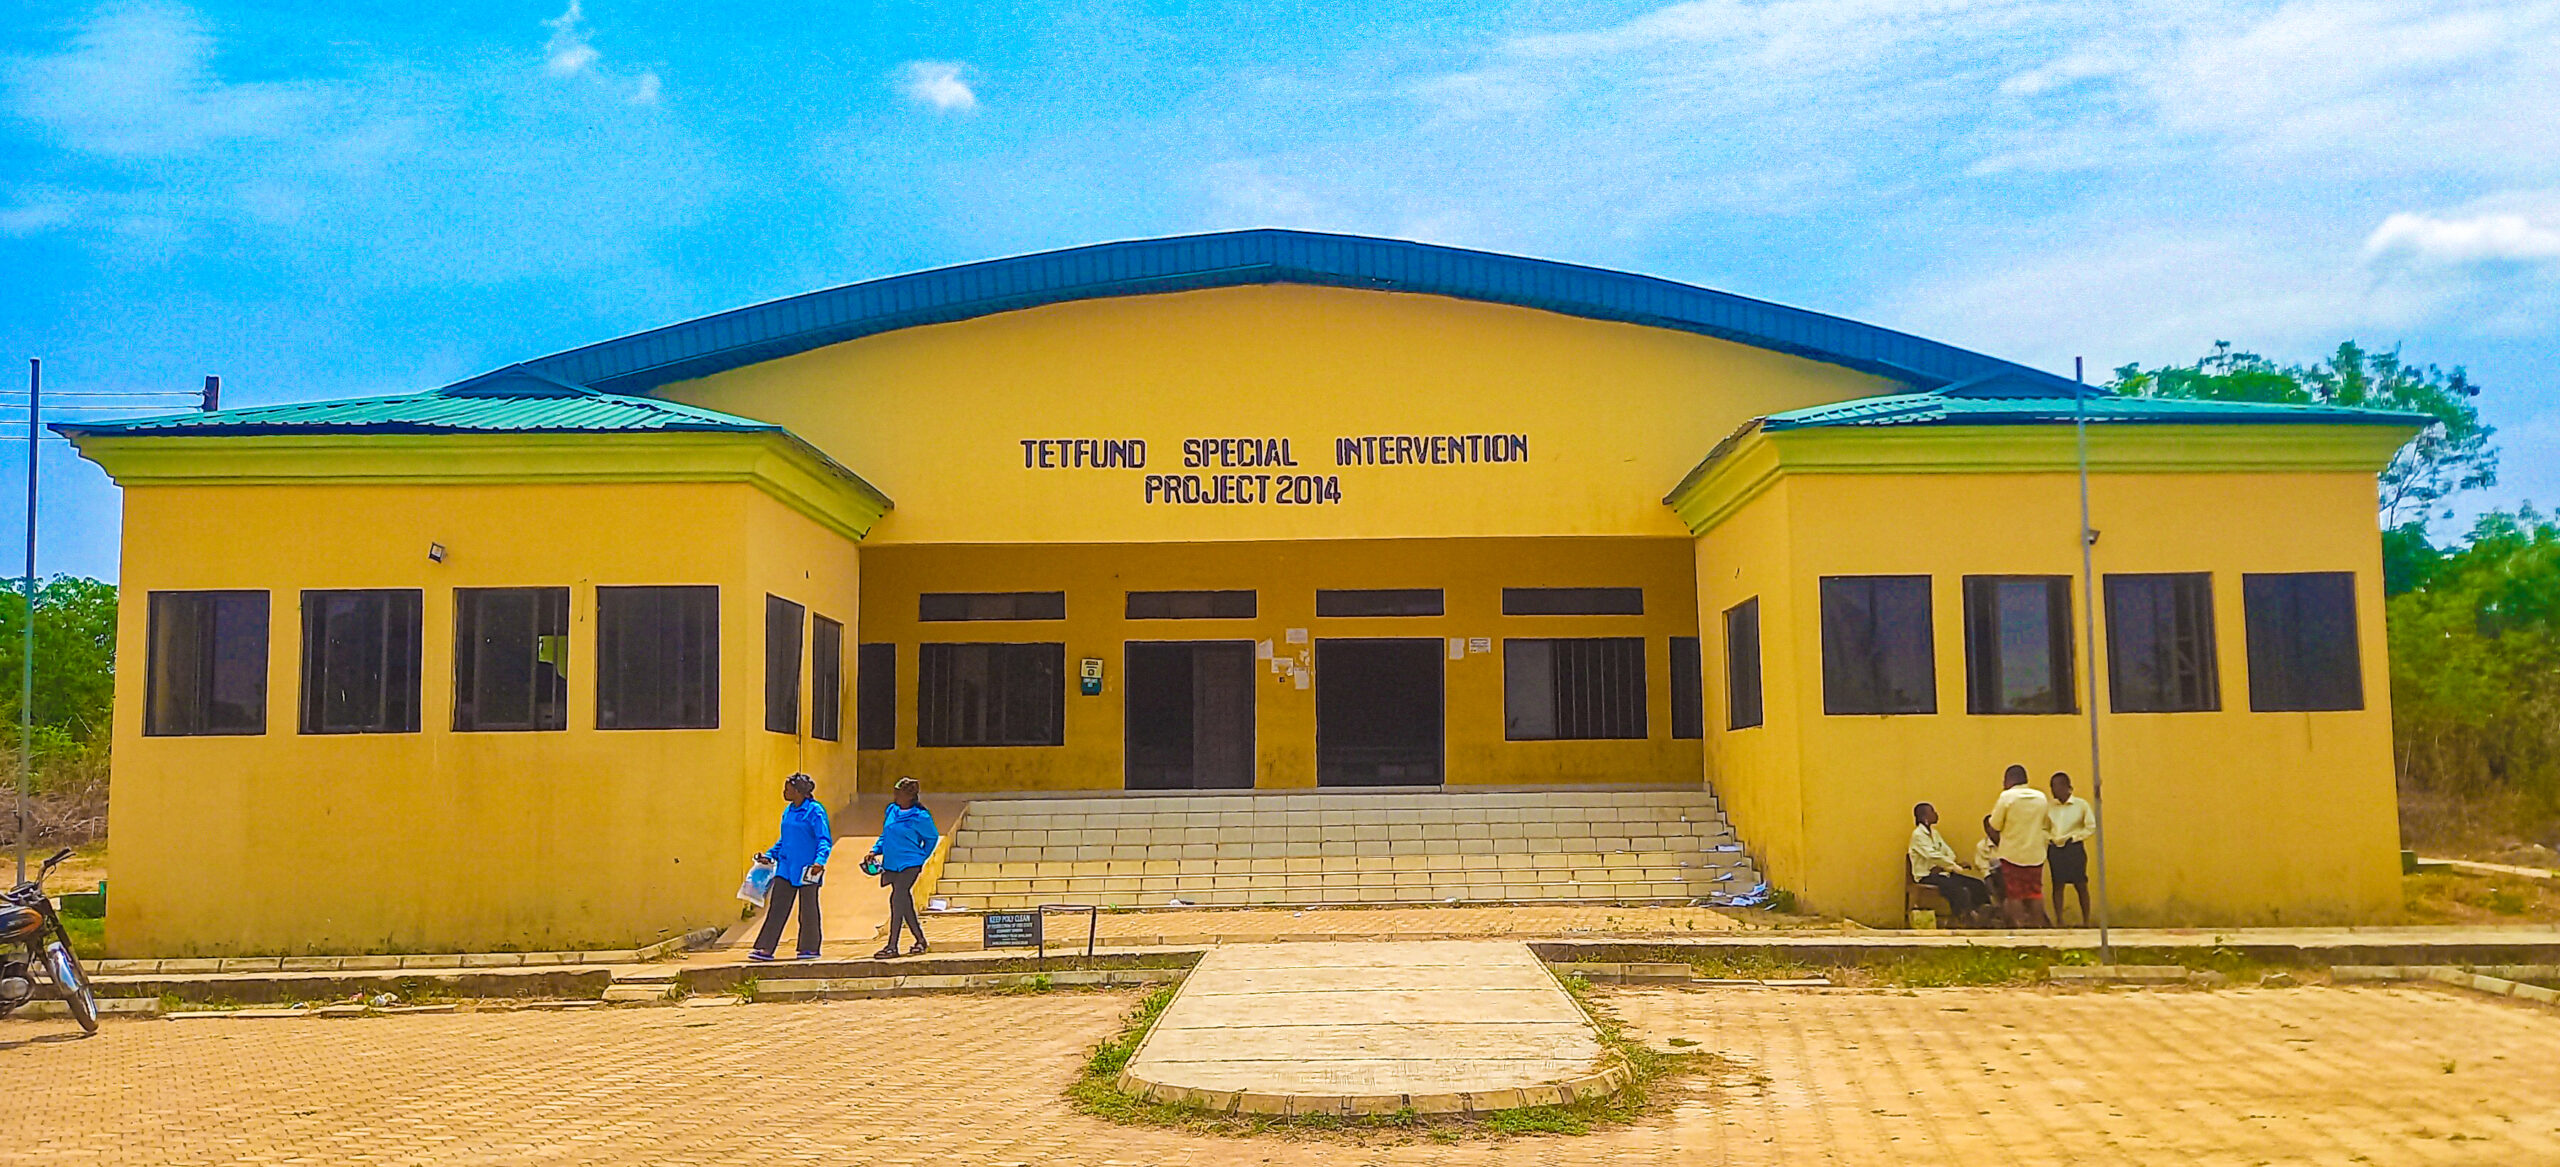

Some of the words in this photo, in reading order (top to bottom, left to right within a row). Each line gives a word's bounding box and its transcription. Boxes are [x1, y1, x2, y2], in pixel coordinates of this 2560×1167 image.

[1020, 439, 1146, 469] TETFUND
[1183, 438, 1298, 467] SPECIAL
[1335, 434, 1528, 466] INTERVENTION
[1145, 475, 1270, 504] PROJECT
[1276, 475, 1342, 504] 2014
[1014, 914, 1031, 922] CLEAN
